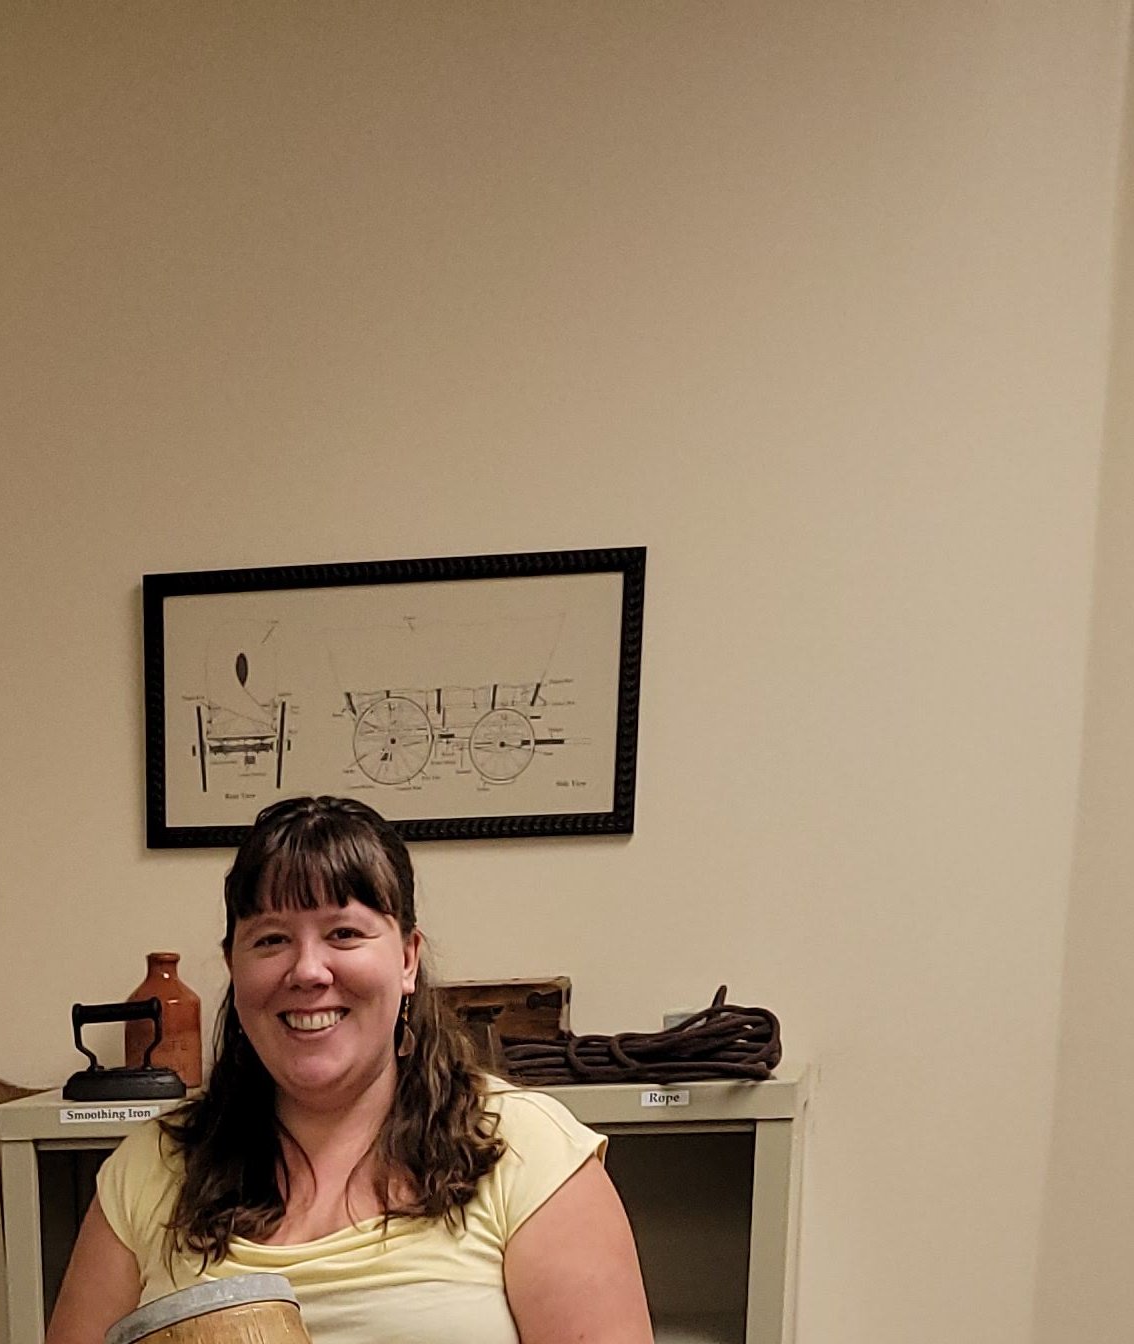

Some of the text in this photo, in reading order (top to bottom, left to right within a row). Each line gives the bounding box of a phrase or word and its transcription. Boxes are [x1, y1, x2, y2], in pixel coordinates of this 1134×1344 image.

[649, 1092, 681, 1106] Rope
[66, 1108, 152, 1121] Smoothing Iron
